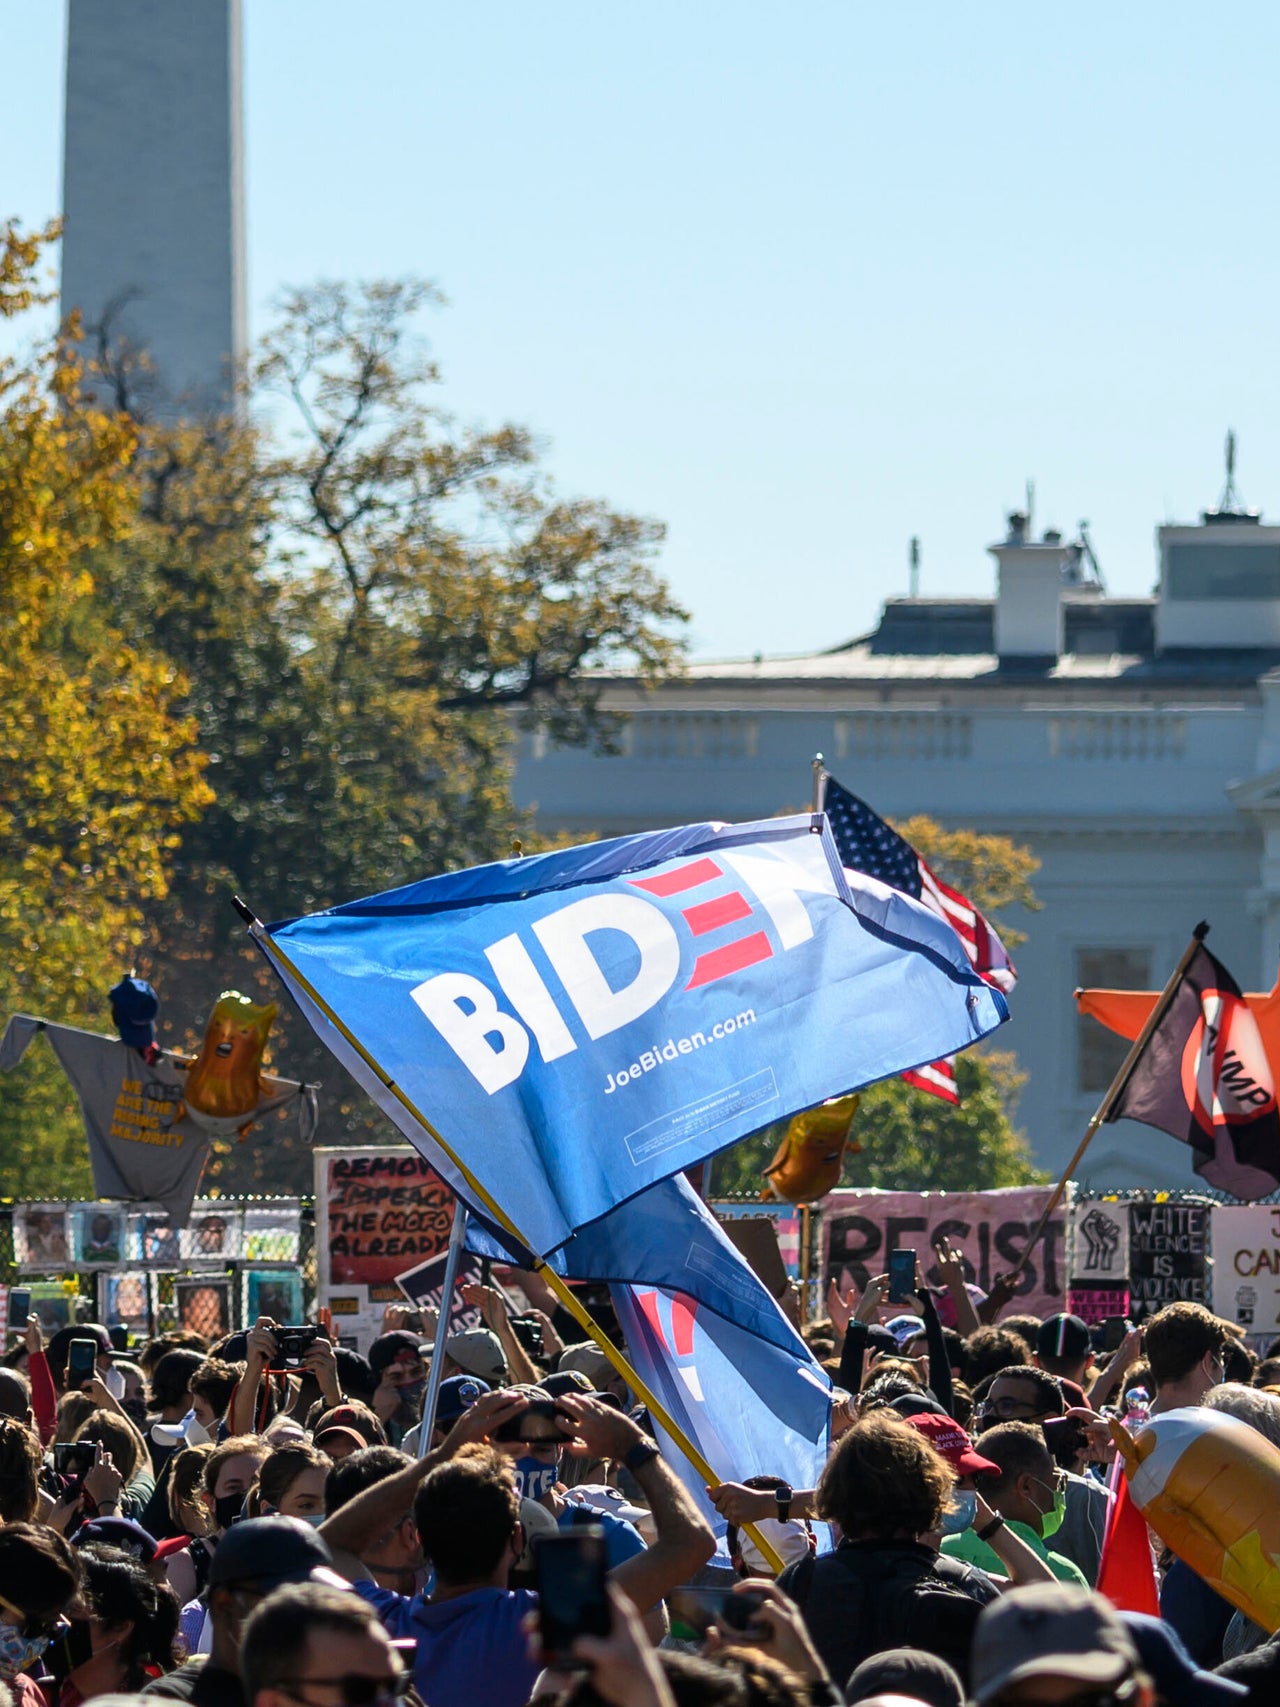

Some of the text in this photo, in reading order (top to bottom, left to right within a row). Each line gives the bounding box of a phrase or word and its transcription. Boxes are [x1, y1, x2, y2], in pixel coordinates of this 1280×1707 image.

[604, 1008, 757, 1095] JoeBiden.com
[110, 1122, 184, 1149] MAJORITY
[332, 1157, 435, 1178] REMOV
[330, 1211, 450, 1233] THE MOFO
[1132, 1207, 1203, 1235] WHITE
[1131, 1235, 1202, 1253] SILENCE
[1153, 1255, 1175, 1276] IS
[1130, 1277, 1202, 1301] VIOLENCE
